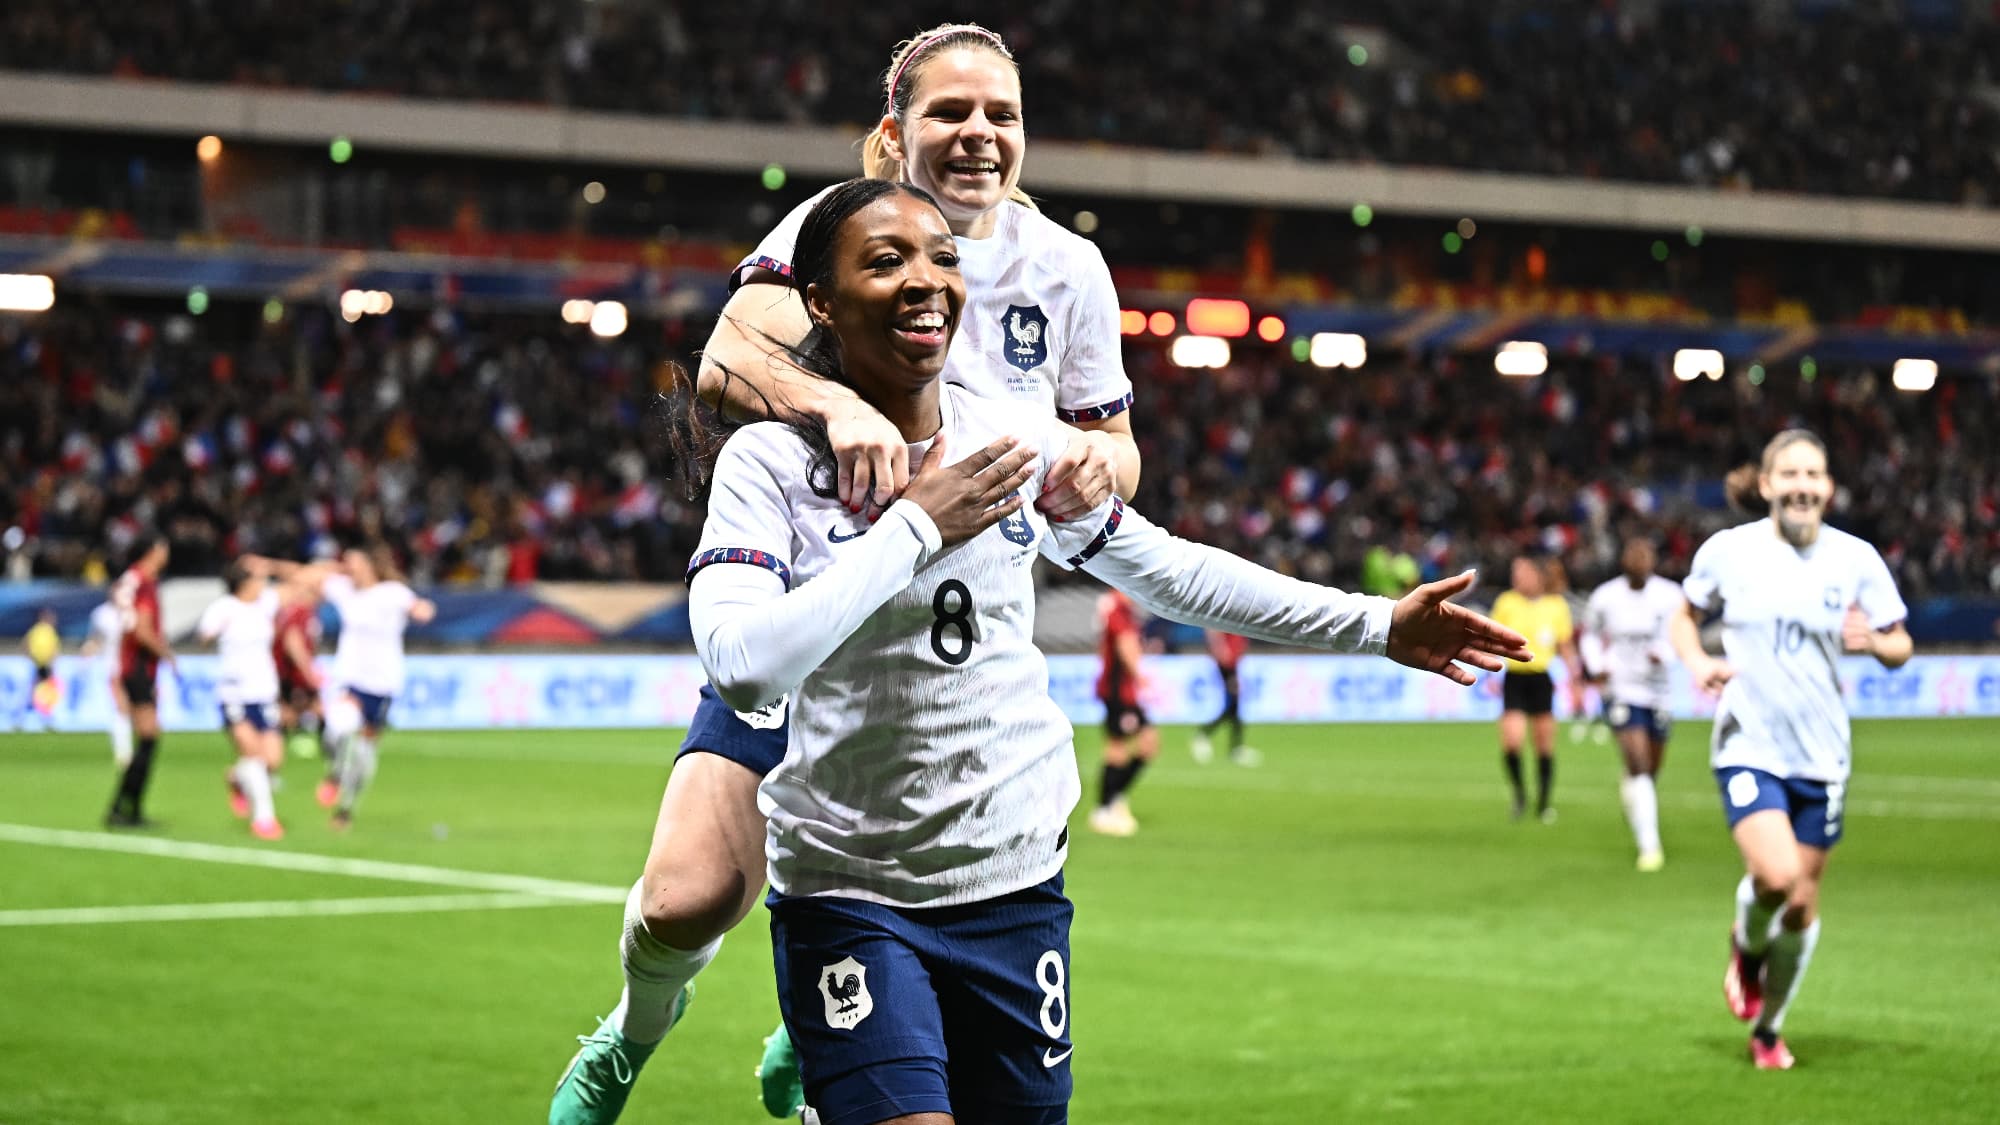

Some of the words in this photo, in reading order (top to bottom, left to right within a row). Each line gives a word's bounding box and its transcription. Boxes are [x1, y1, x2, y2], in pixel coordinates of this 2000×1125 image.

[930, 578, 973, 666] 8
[1773, 617, 1806, 656] 10
[1035, 950, 1066, 1039] 8
